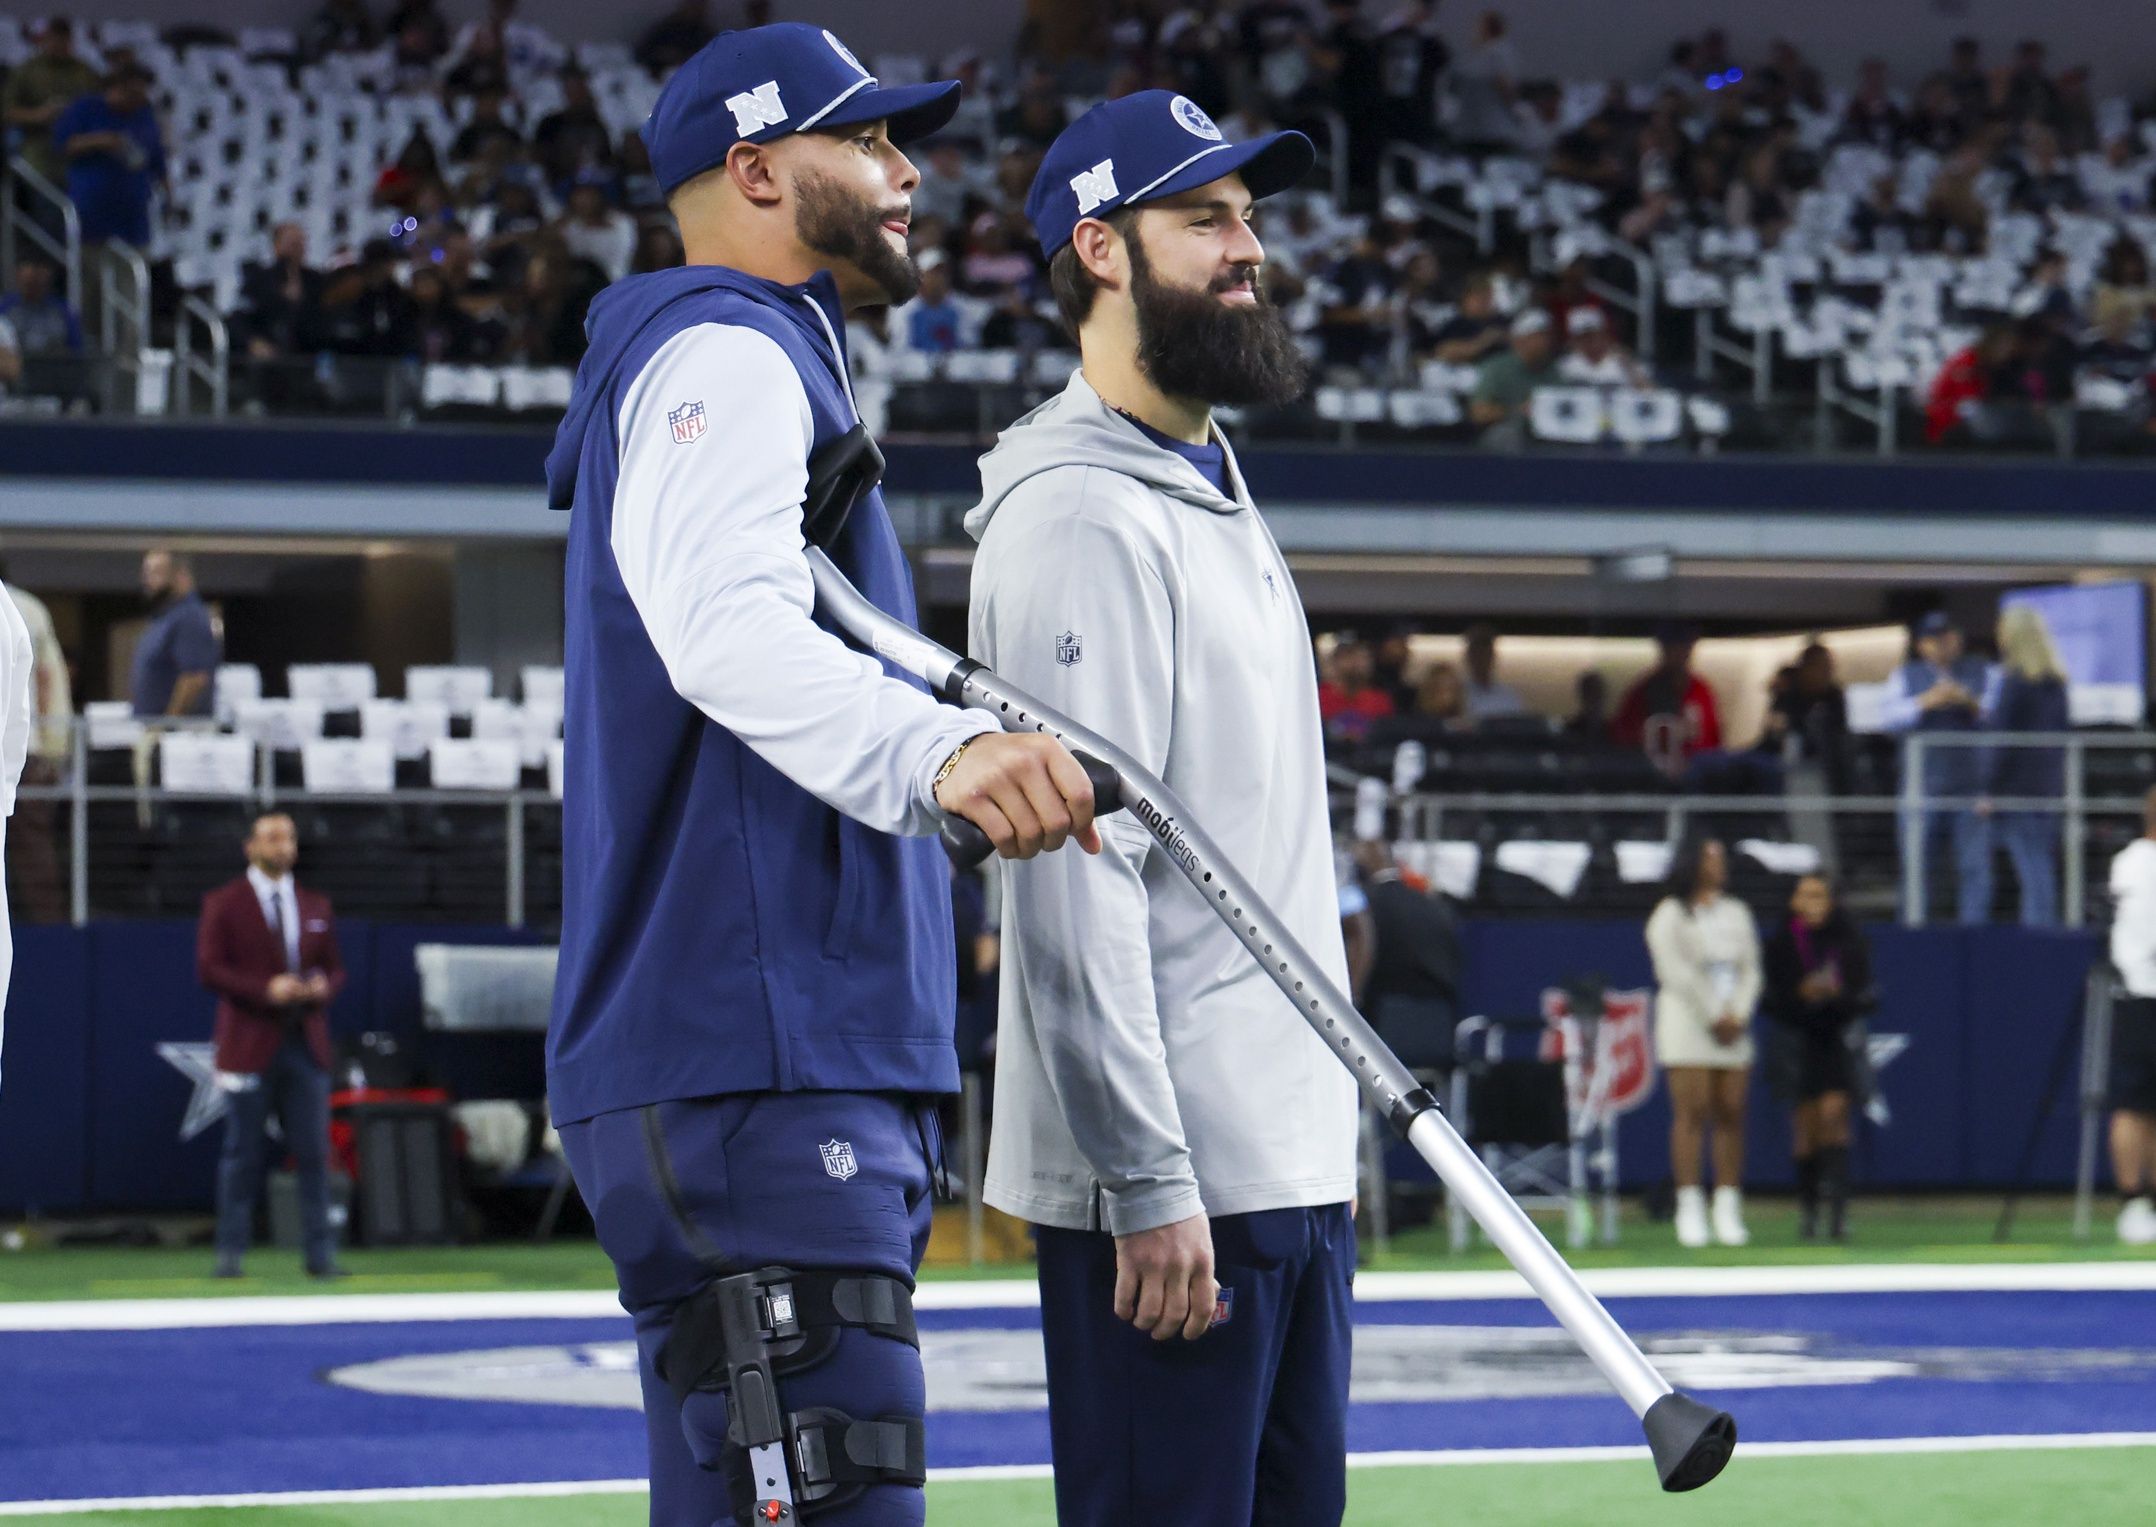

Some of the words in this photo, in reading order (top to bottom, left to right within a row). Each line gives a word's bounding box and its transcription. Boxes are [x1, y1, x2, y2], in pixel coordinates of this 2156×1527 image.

[725, 80, 789, 138] N
[1069, 158, 1120, 216] N
[675, 416, 705, 441] NFL
[1059, 647, 1080, 662] NFL
[1137, 797, 1200, 871] mobilegs
[828, 1156, 854, 1173] NFL
